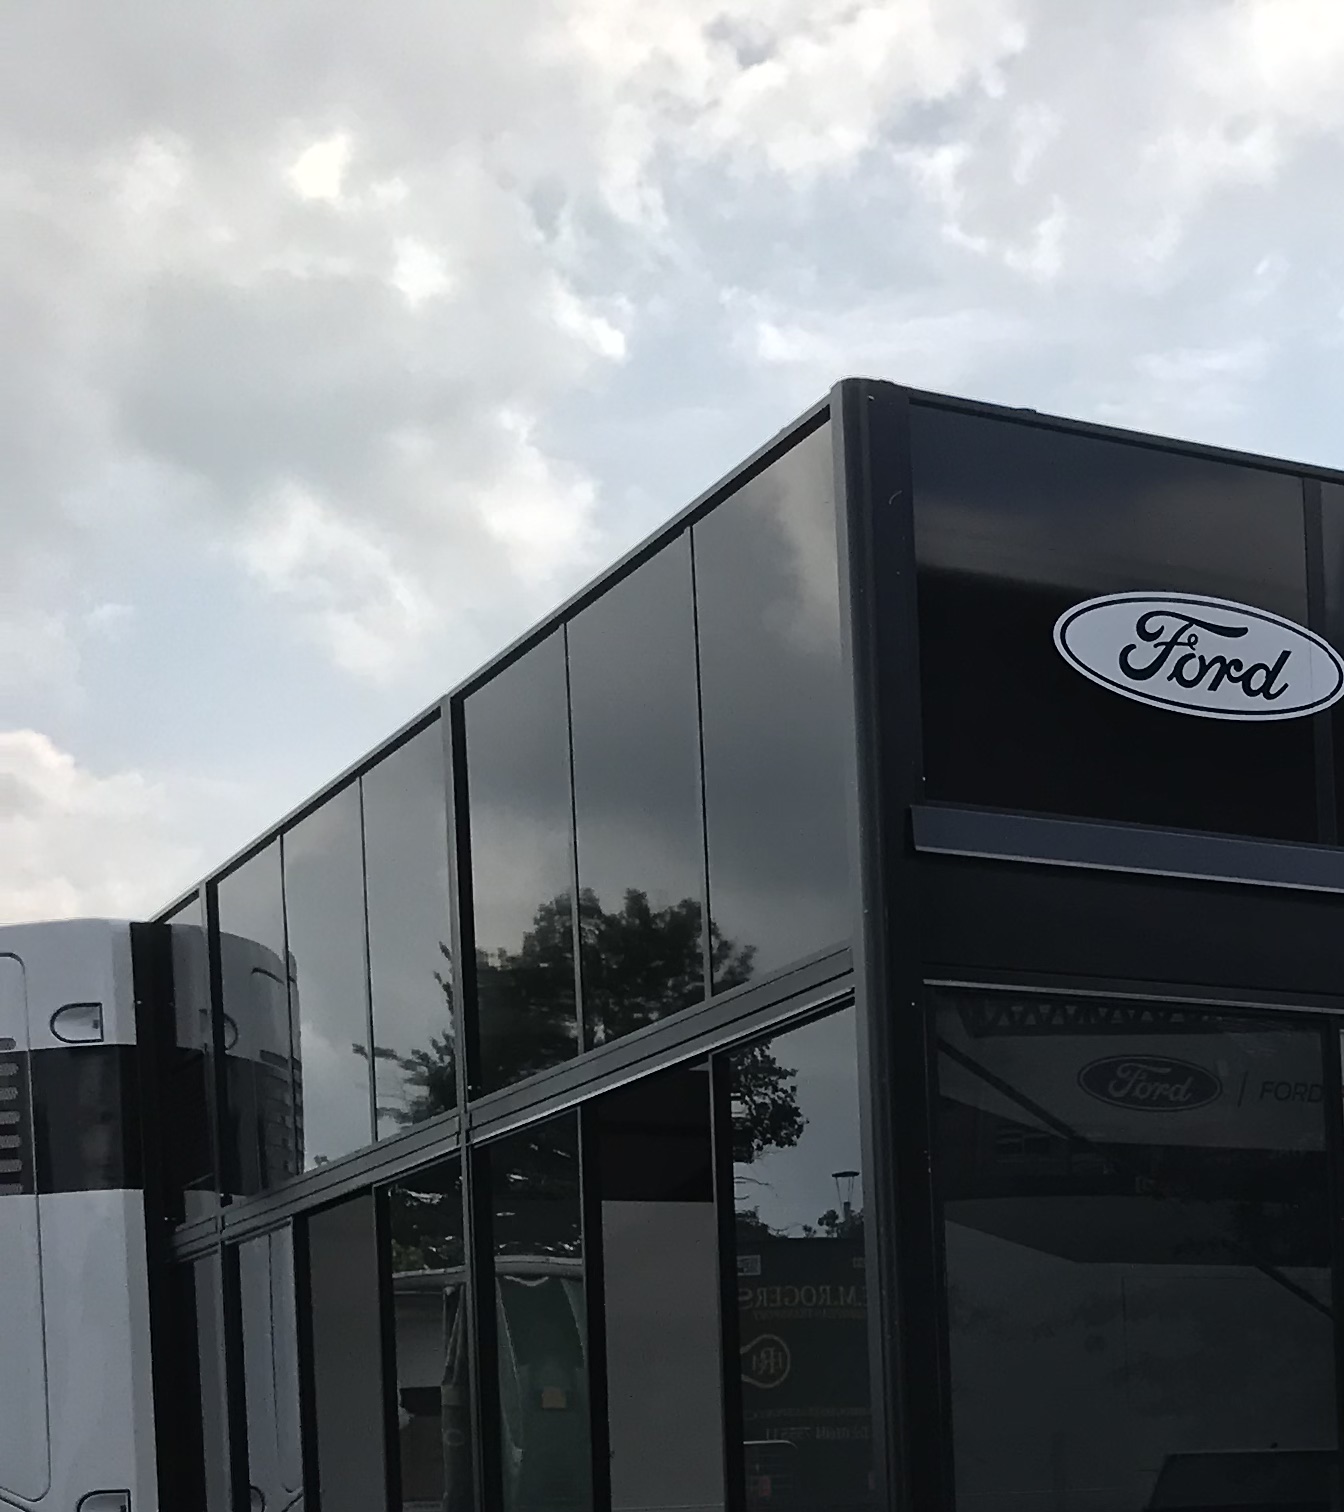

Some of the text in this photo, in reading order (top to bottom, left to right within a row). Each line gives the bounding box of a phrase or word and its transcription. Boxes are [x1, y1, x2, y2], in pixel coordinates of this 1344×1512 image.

[1117, 610, 1292, 702] Ford
[1108, 1063, 1195, 1102] Ford
[1260, 1080, 1326, 1102] FORD
